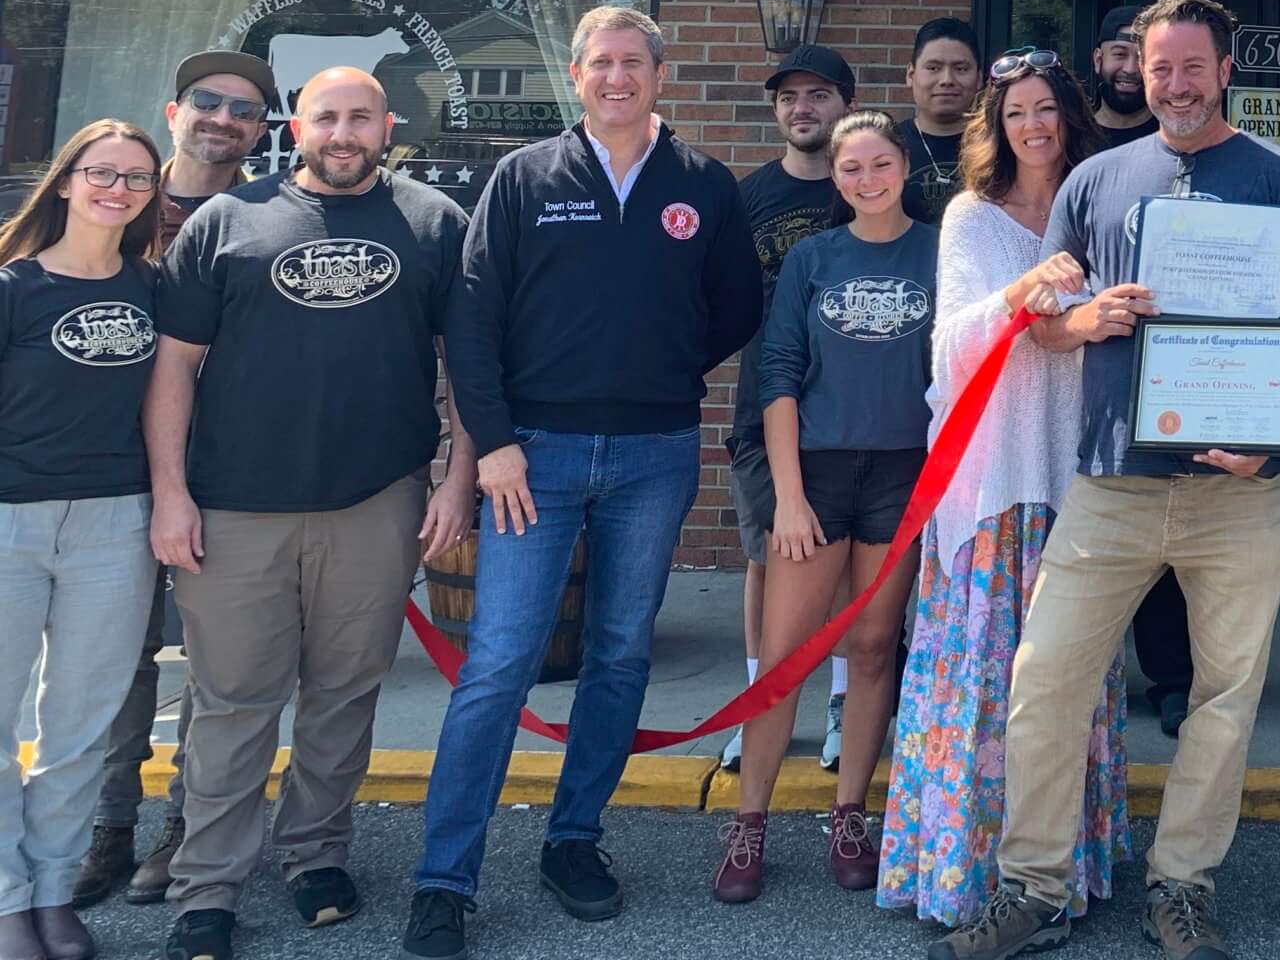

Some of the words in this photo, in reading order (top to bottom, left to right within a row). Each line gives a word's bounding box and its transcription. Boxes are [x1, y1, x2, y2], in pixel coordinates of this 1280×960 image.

[405, 12, 456, 73] FRENCH
[444, 69, 469, 130] TOAST
[544, 201, 565, 212] Town
[566, 199, 595, 210] Council
[300, 244, 372, 280] toast
[842, 281, 908, 314] toast
[78, 308, 141, 340] toast
[1152, 334, 1199, 345] Certificate
[1200, 335, 1210, 345] of
